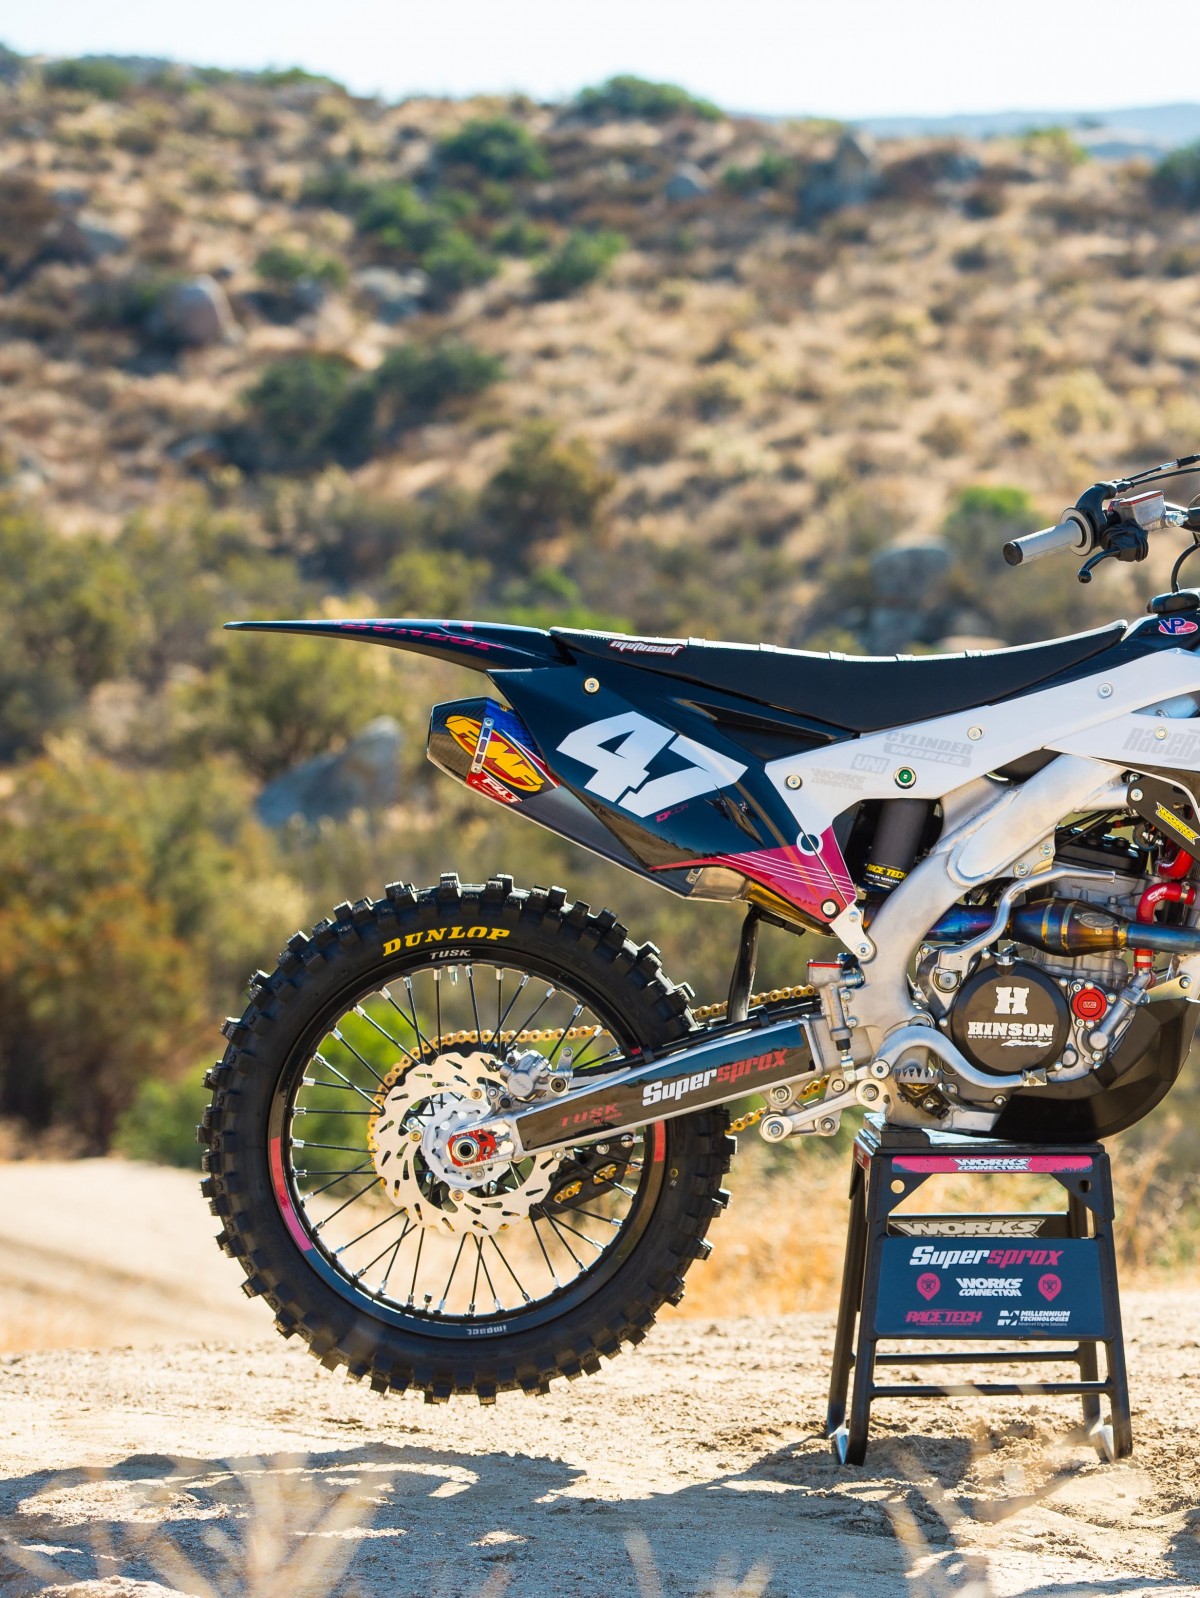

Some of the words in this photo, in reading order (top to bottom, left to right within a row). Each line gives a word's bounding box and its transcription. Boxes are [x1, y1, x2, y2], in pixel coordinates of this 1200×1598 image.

[1159, 618, 1186, 634] VP
[885, 731, 974, 755] CYLINDER
[890, 744, 964, 764] WORKS
[556, 711, 749, 818] 47
[383, 926, 510, 956] DUNLOP
[430, 949, 471, 960] TUSK
[994, 986, 1030, 1015] H
[967, 1021, 1054, 1037] HINSON
[642, 1048, 788, 1107] Supersprox
[561, 1103, 619, 1127] TUSK
[953, 1158, 1031, 1166] WORKS
[898, 1220, 1042, 1236] WORKS
[909, 1245, 1064, 1269] Supersprox
[955, 1278, 1024, 1289] WORKS
[958, 1288, 1023, 1297] CONNECTION
[905, 1311, 942, 1323] RACE
[944, 1310, 983, 1323] TECH
[1020, 1310, 1071, 1318] MILLENNIUM
